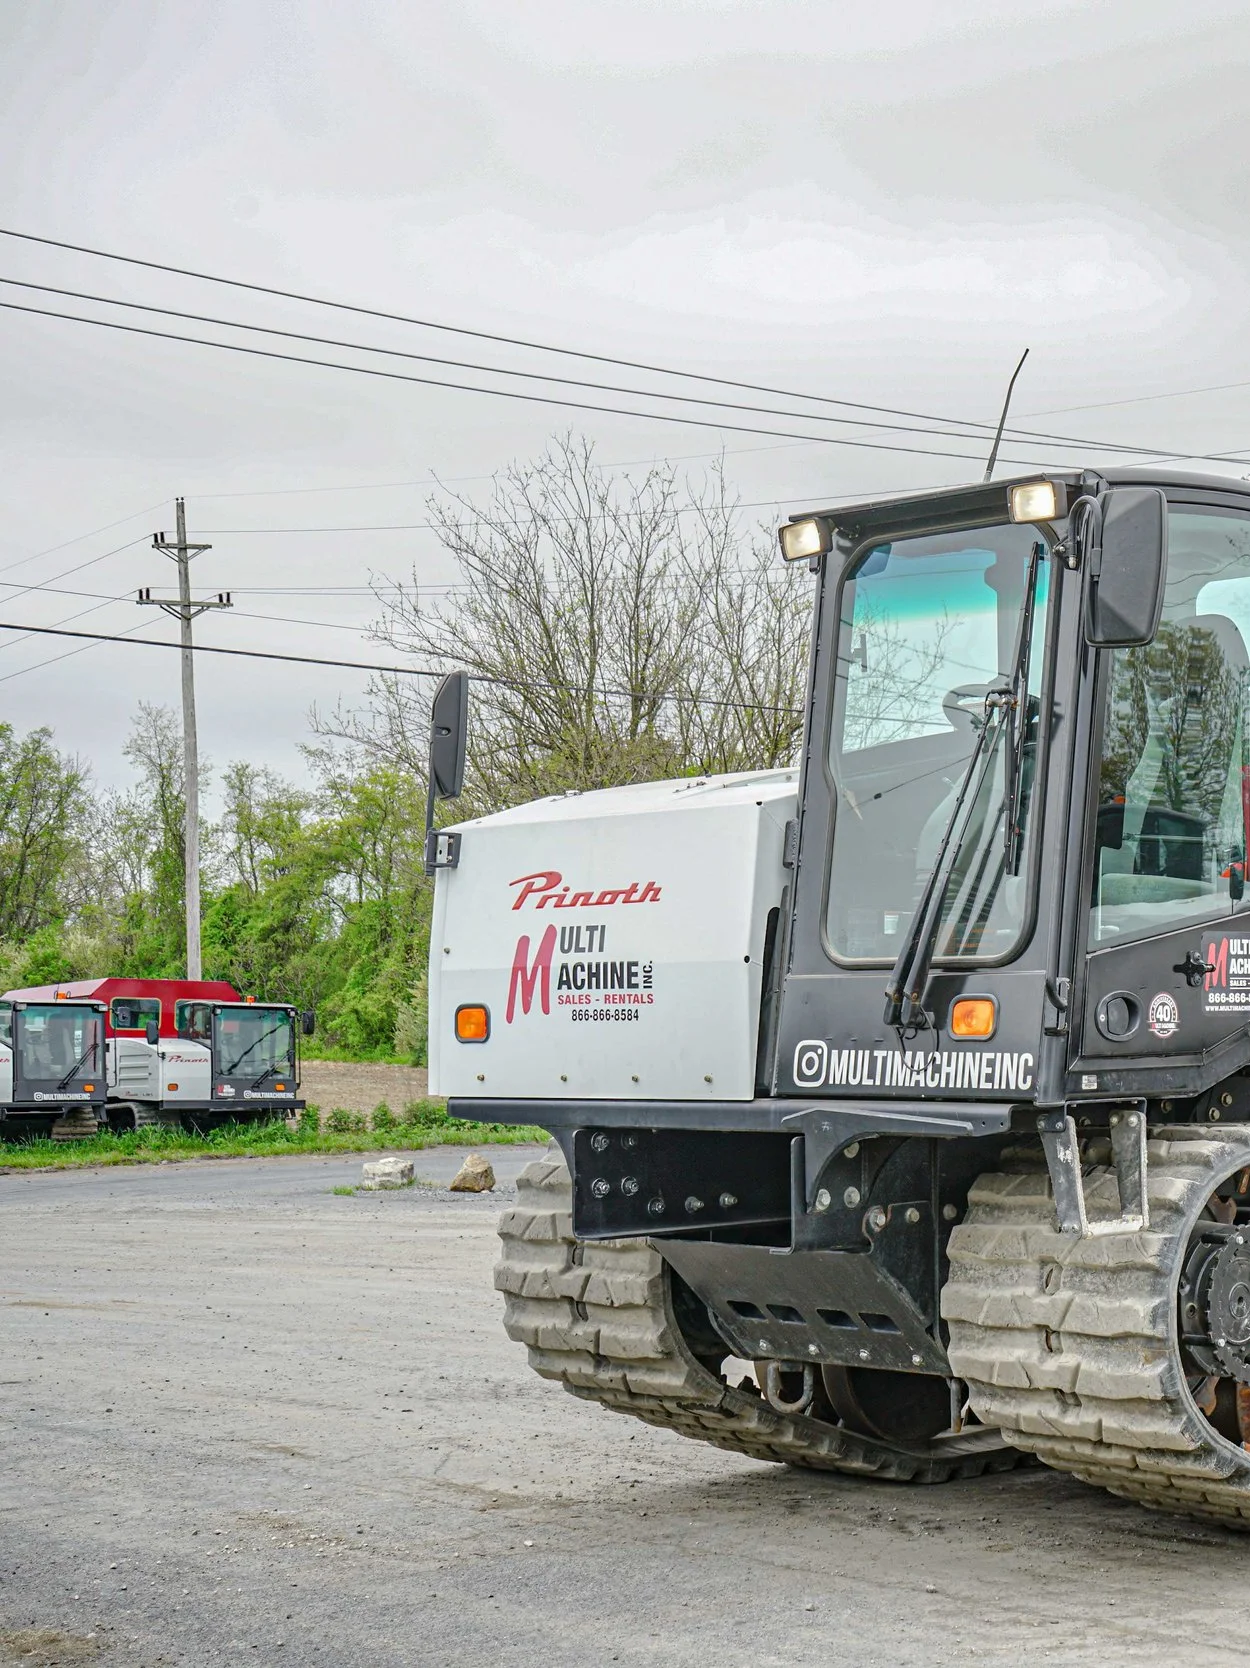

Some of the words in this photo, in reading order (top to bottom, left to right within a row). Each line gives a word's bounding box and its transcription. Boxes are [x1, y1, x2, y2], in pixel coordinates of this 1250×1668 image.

[509, 870, 662, 910] Prinoth
[643, 961, 653, 989] INC.
[558, 994, 592, 1005] SALES
[604, 993, 654, 1004] RENTALS
[571, 1008, 640, 1022] 866-866-8584
[1156, 1005, 1171, 1022] 40
[828, 1049, 1034, 1091] MULTIMACHINEINC
